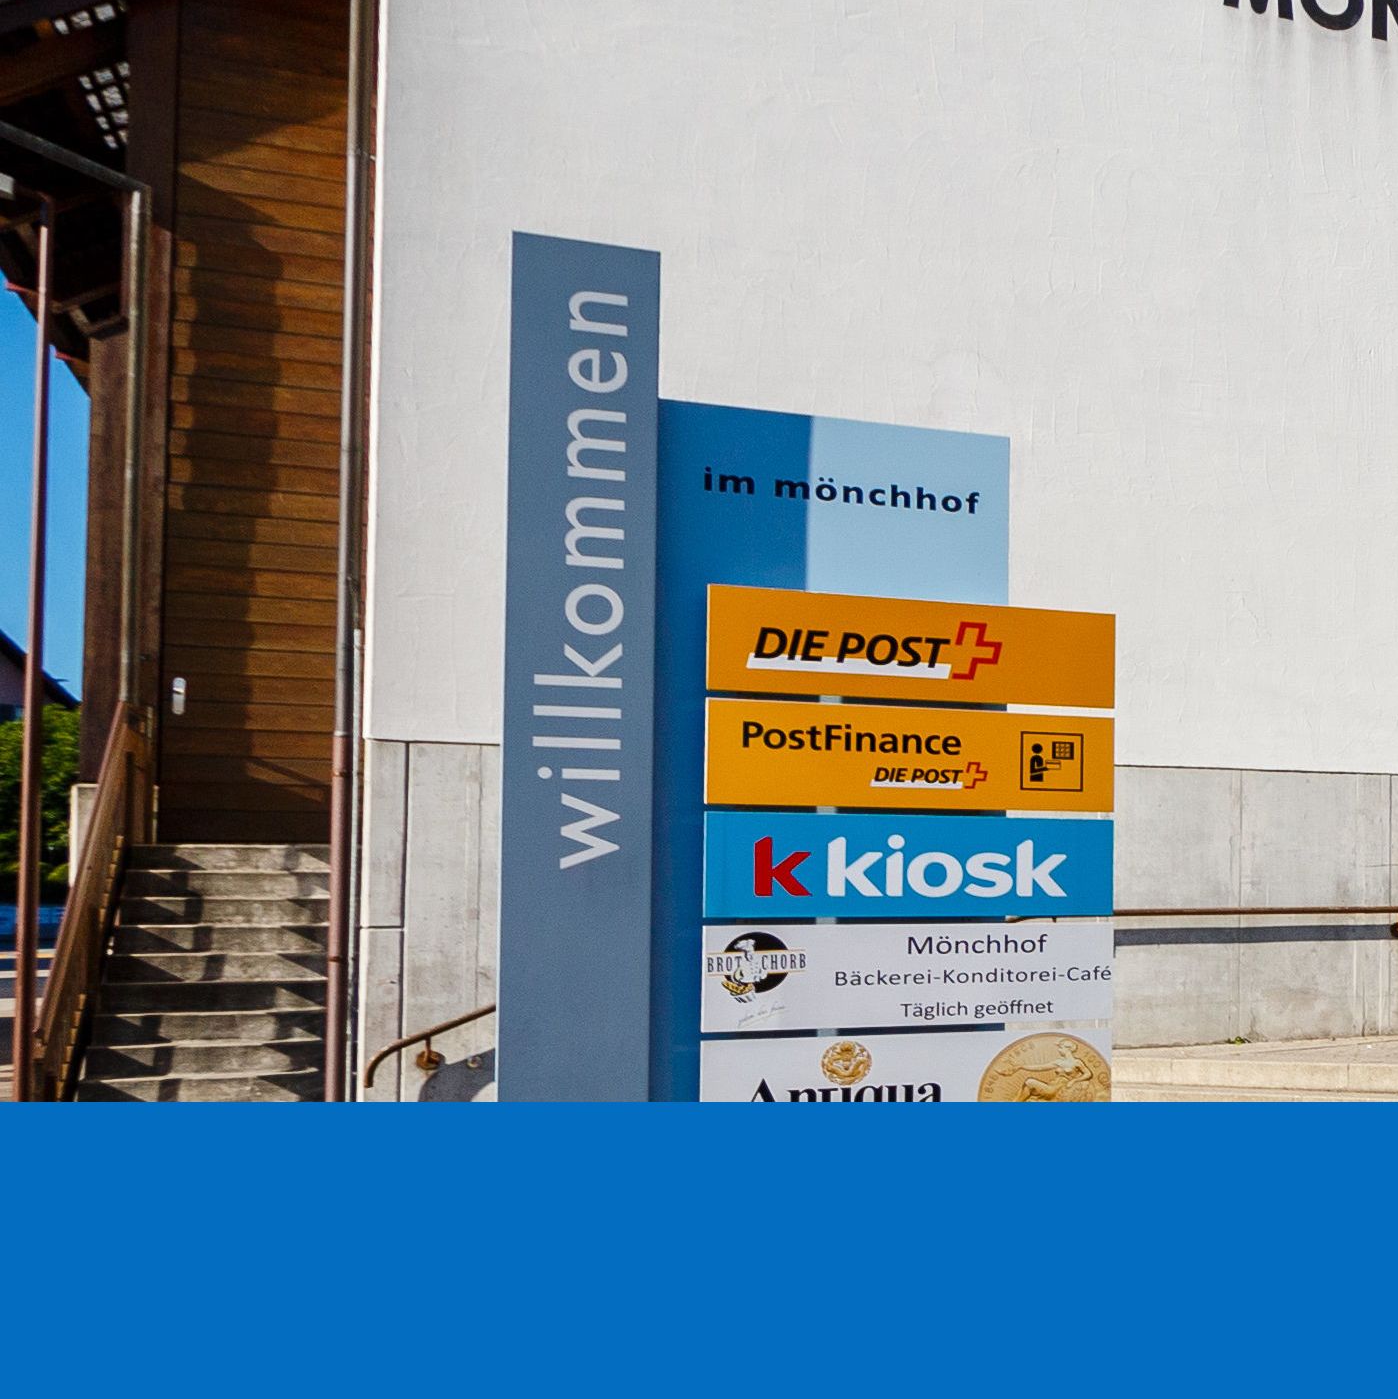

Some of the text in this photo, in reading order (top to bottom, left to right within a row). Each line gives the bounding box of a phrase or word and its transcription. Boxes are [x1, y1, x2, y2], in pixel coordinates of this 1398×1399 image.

[703, 466, 981, 514] im mönchhof
[532, 291, 629, 869] willkommen
[754, 627, 950, 669] DIE POST
[742, 721, 962, 756] PostFinance
[873, 767, 963, 784] DIE POST
[754, 834, 1067, 898] k kiosk
[907, 934, 1048, 955] Mönchhof
[707, 953, 806, 972] BROT CHORB
[835, 965, 1112, 986] Bäckerei-Konditorei-Café
[901, 999, 1054, 1020] Täglich geöffnet
